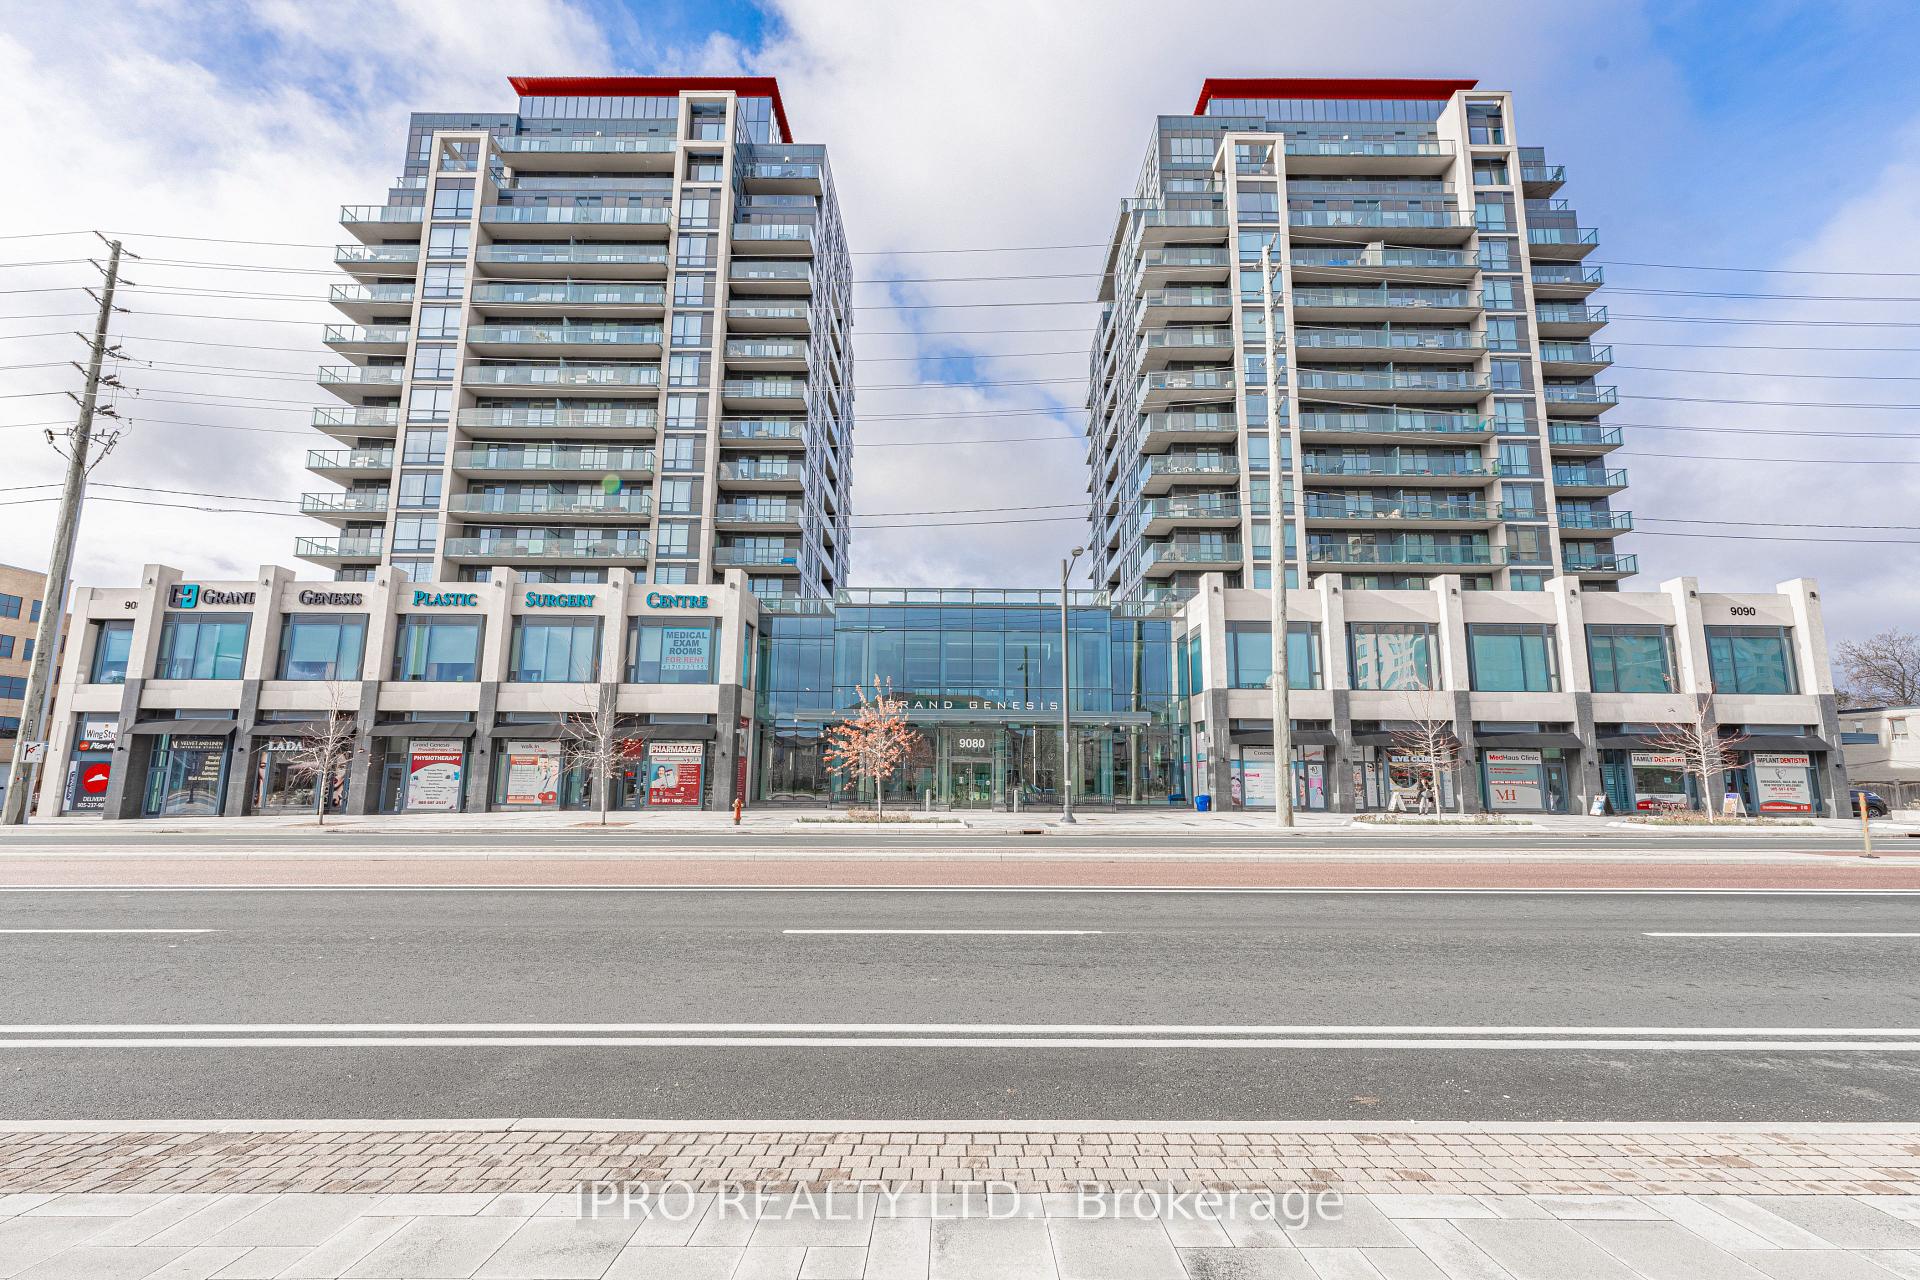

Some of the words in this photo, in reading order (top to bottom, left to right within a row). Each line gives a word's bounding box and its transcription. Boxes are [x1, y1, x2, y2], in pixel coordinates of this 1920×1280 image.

[299, 589, 363, 606] GENESIS
[412, 590, 478, 607] PLASTIC
[525, 591, 596, 608] SURGERY
[646, 591, 709, 609] CENTRE
[124, 601, 138, 610] 90
[1730, 607, 1756, 616] 9090
[666, 631, 707, 639] MEDICAL
[684, 656, 704, 664] RENT
[969, 701, 1058, 710] GENESIS
[959, 738, 985, 749] 9080
[651, 745, 701, 754] PHARMASAVE
[1391, 755, 1410, 763] EYE
